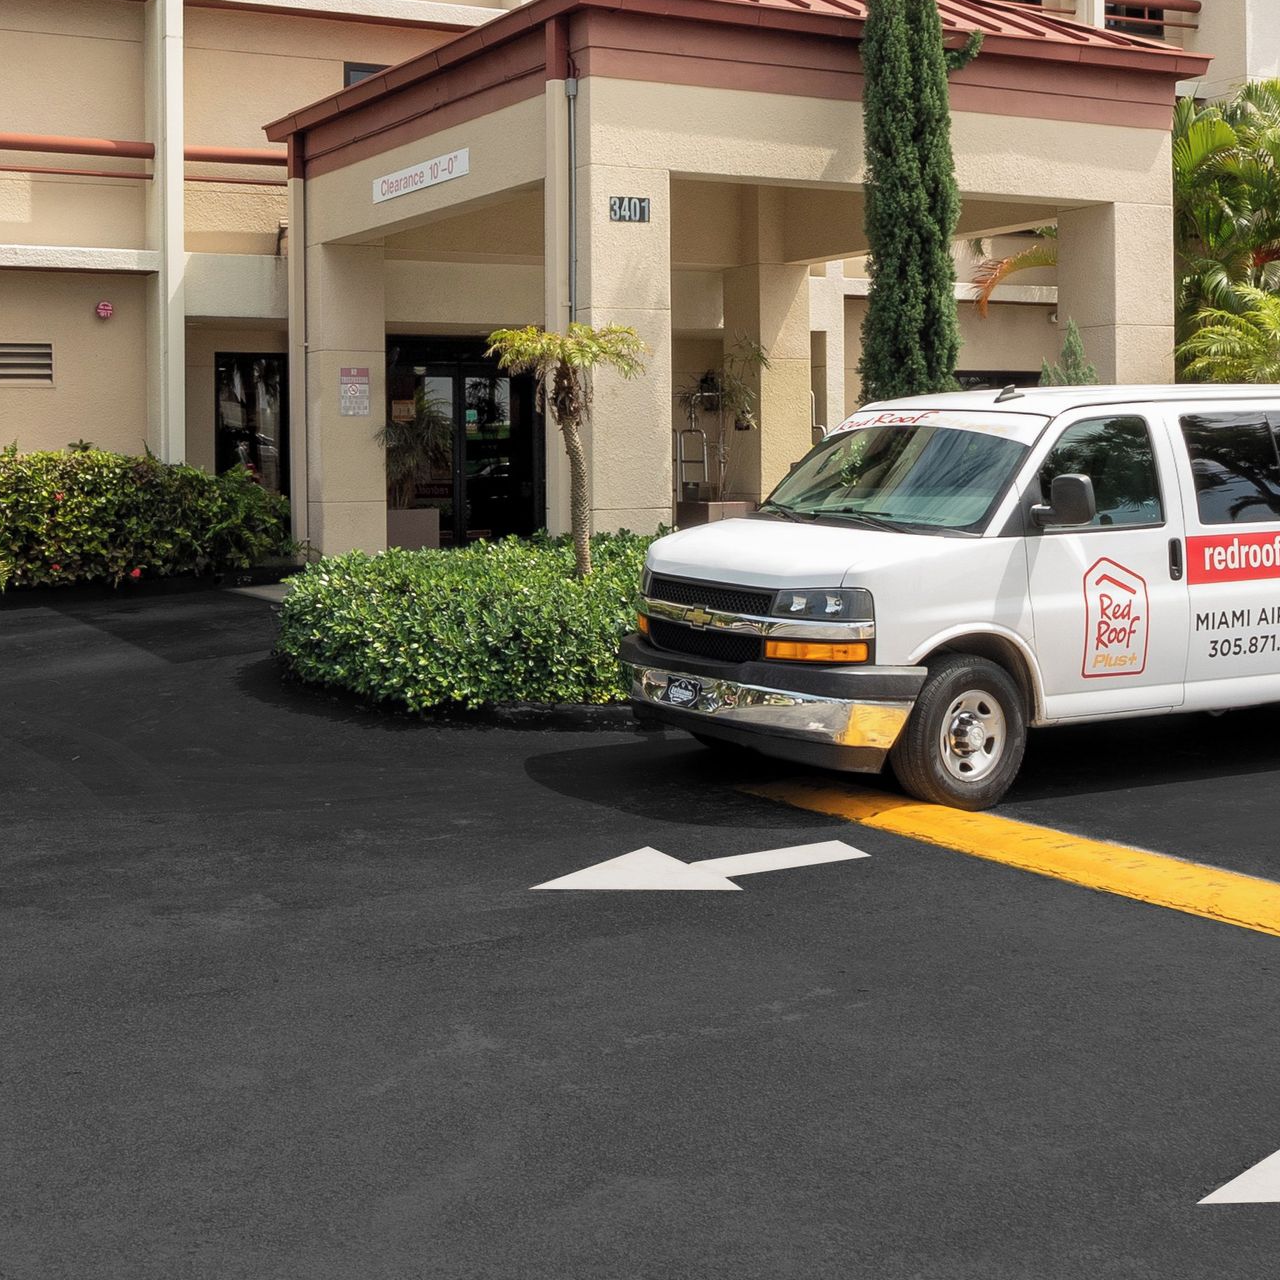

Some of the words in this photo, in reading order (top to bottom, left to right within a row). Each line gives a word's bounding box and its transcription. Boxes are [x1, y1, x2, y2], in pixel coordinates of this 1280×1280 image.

[380, 170, 425, 197] Clearance
[610, 197, 649, 222] 3401
[871, 410, 940, 425] Roof
[1099, 593, 1132, 621] Red
[1195, 609, 1250, 631] MIAMI
[1096, 616, 1140, 651] Roof
[1092, 652, 1138, 668] Plus+
